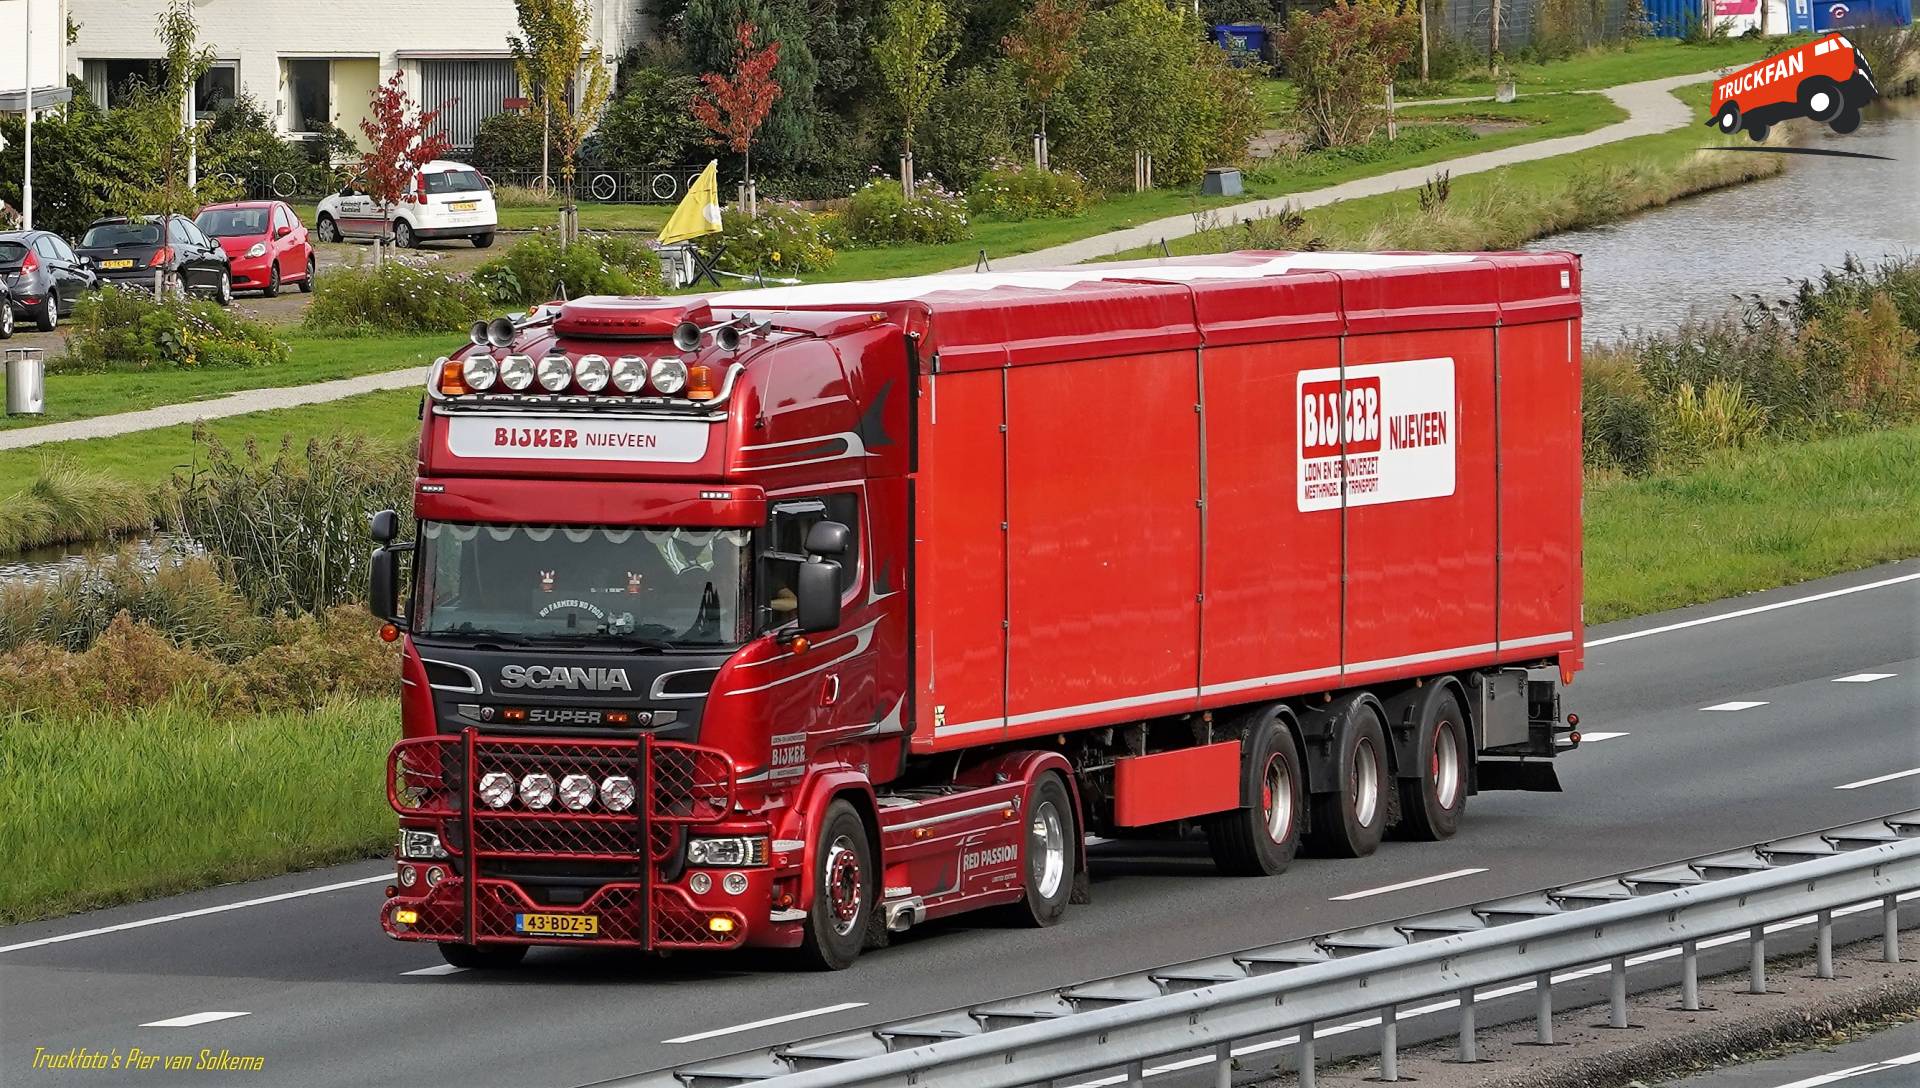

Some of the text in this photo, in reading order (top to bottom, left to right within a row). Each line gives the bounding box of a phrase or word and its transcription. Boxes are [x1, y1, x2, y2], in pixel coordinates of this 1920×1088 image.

[1304, 387, 1379, 447] BIJKER
[494, 427, 656, 448] BIJKER NIJEVEEN
[1390, 411, 1447, 450] NIJEVEEN
[1305, 462, 1321, 481] LOON
[1324, 461, 1332, 479] EN
[1305, 482, 1339, 499] MESTHANDEL
[1349, 478, 1378, 495] TRANSPORT
[539, 600, 604, 619] NO FARMERS NO FOOD
[500, 664, 633, 692] SCANIA
[529, 709, 602, 724] SUPER
[772, 745, 806, 766] BIJKER
[963, 843, 1018, 873] RED PASSION
[527, 916, 593, 931] 43-BDZ-5
